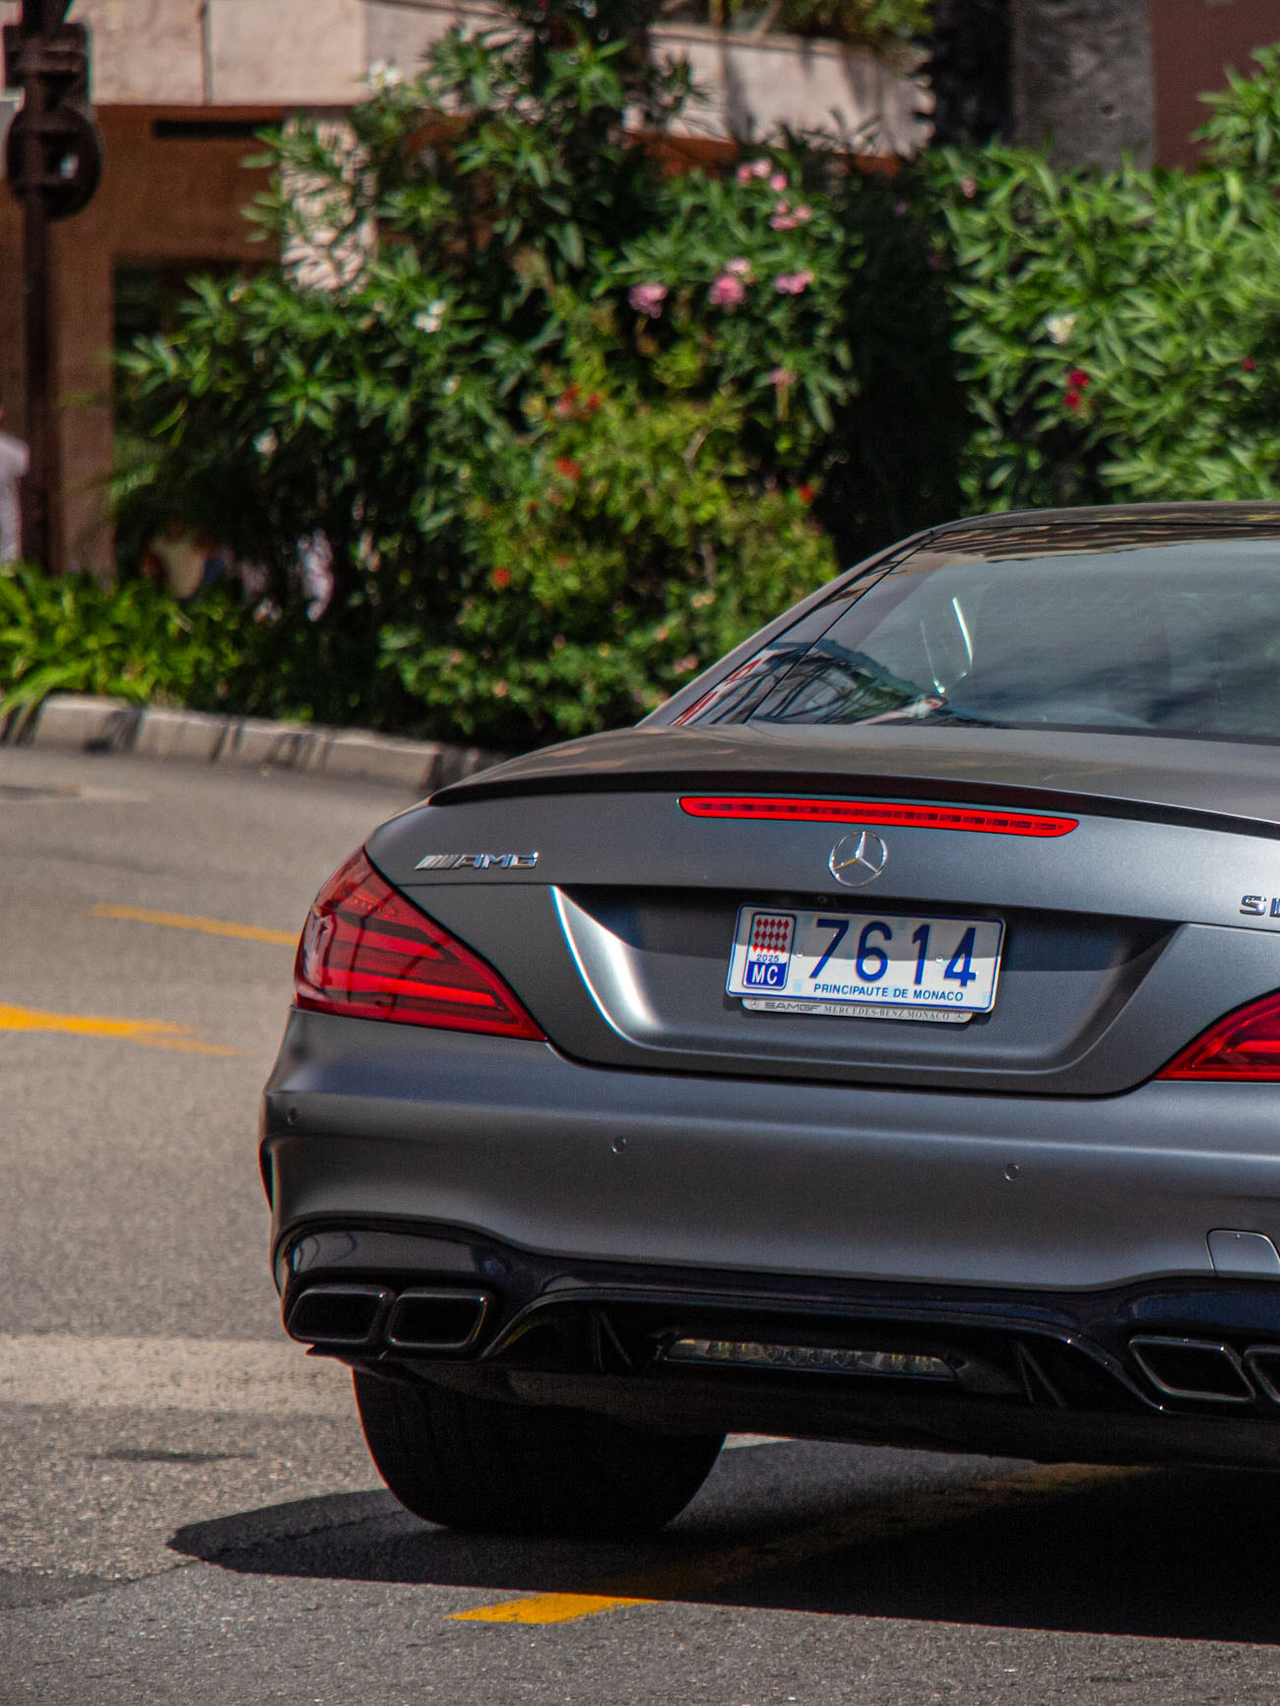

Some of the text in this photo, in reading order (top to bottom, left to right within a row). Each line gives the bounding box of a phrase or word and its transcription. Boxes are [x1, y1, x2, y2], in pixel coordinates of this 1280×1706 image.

[756, 953, 780, 963] 2025
[808, 918, 977, 988] 7614
[751, 964, 779, 985] MC
[813, 983, 964, 1002] PRINCIPAUTE DE MONACO
[824, 1005, 904, 1018] MERCEDES-BENZ
[908, 1010, 950, 1020] MONACO
